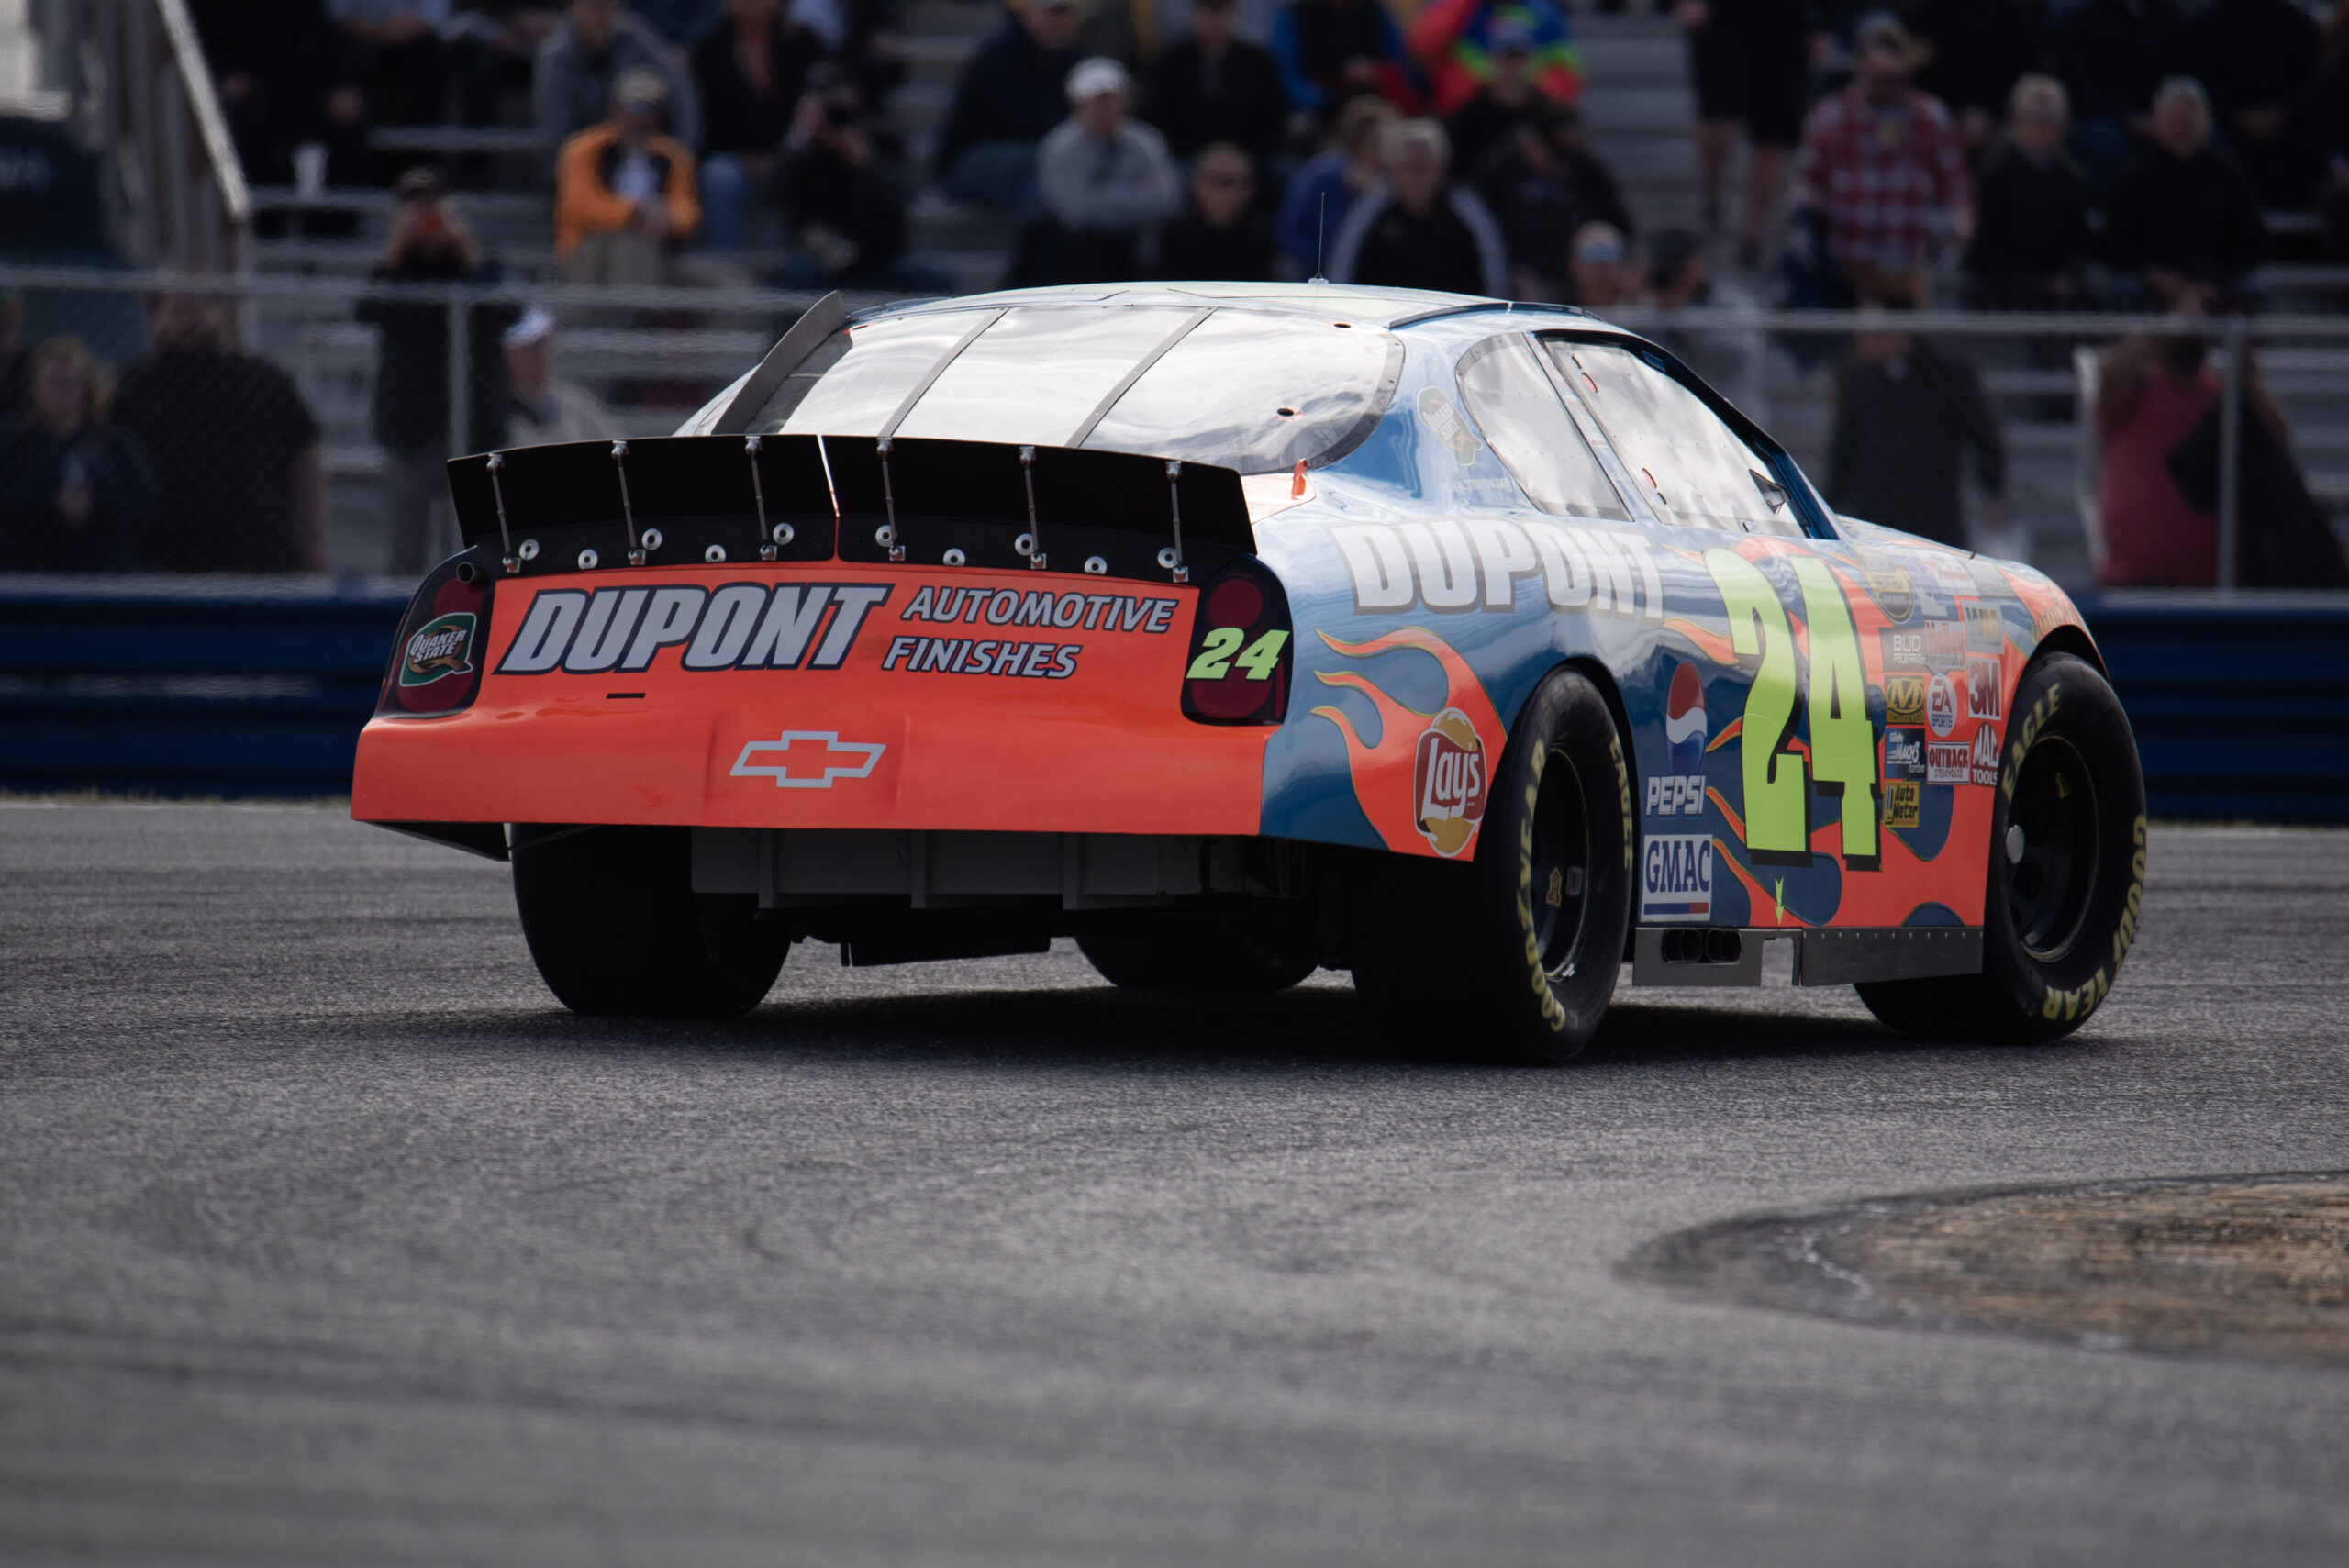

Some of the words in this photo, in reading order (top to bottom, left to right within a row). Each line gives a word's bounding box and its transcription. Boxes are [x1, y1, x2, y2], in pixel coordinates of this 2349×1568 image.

[1326, 517, 1665, 628] DUPONT
[493, 582, 896, 675] DUPONT
[900, 585, 1181, 634] AUTOMOTIVE
[409, 629, 468, 657] QUAKER
[413, 642, 458, 663] STATE
[881, 636, 1083, 680] FINISHES
[1186, 627, 1290, 681] 24
[1893, 634, 1921, 652] BUD
[1704, 547, 1879, 869] 24
[1932, 678, 1953, 713] EA
[1969, 659, 2000, 717] 3M
[1931, 713, 1953, 728] SPORTS
[1929, 747, 1969, 769] OUTBACK
[1972, 723, 1998, 768] MAC
[1999, 681, 2063, 806] EAGLE
[1419, 737, 1481, 823] Lay's
[1908, 761, 1925, 773] Turbo
[1933, 767, 1964, 779] STEAKHOUSE
[1972, 768, 1998, 786] TOOLS
[1609, 732, 1633, 872] EAGLE
[1646, 774, 1707, 818] PEPSI
[1893, 802, 1918, 820] Meter
[1895, 785, 1915, 803] Auto
[1644, 839, 1711, 894] GMAC
